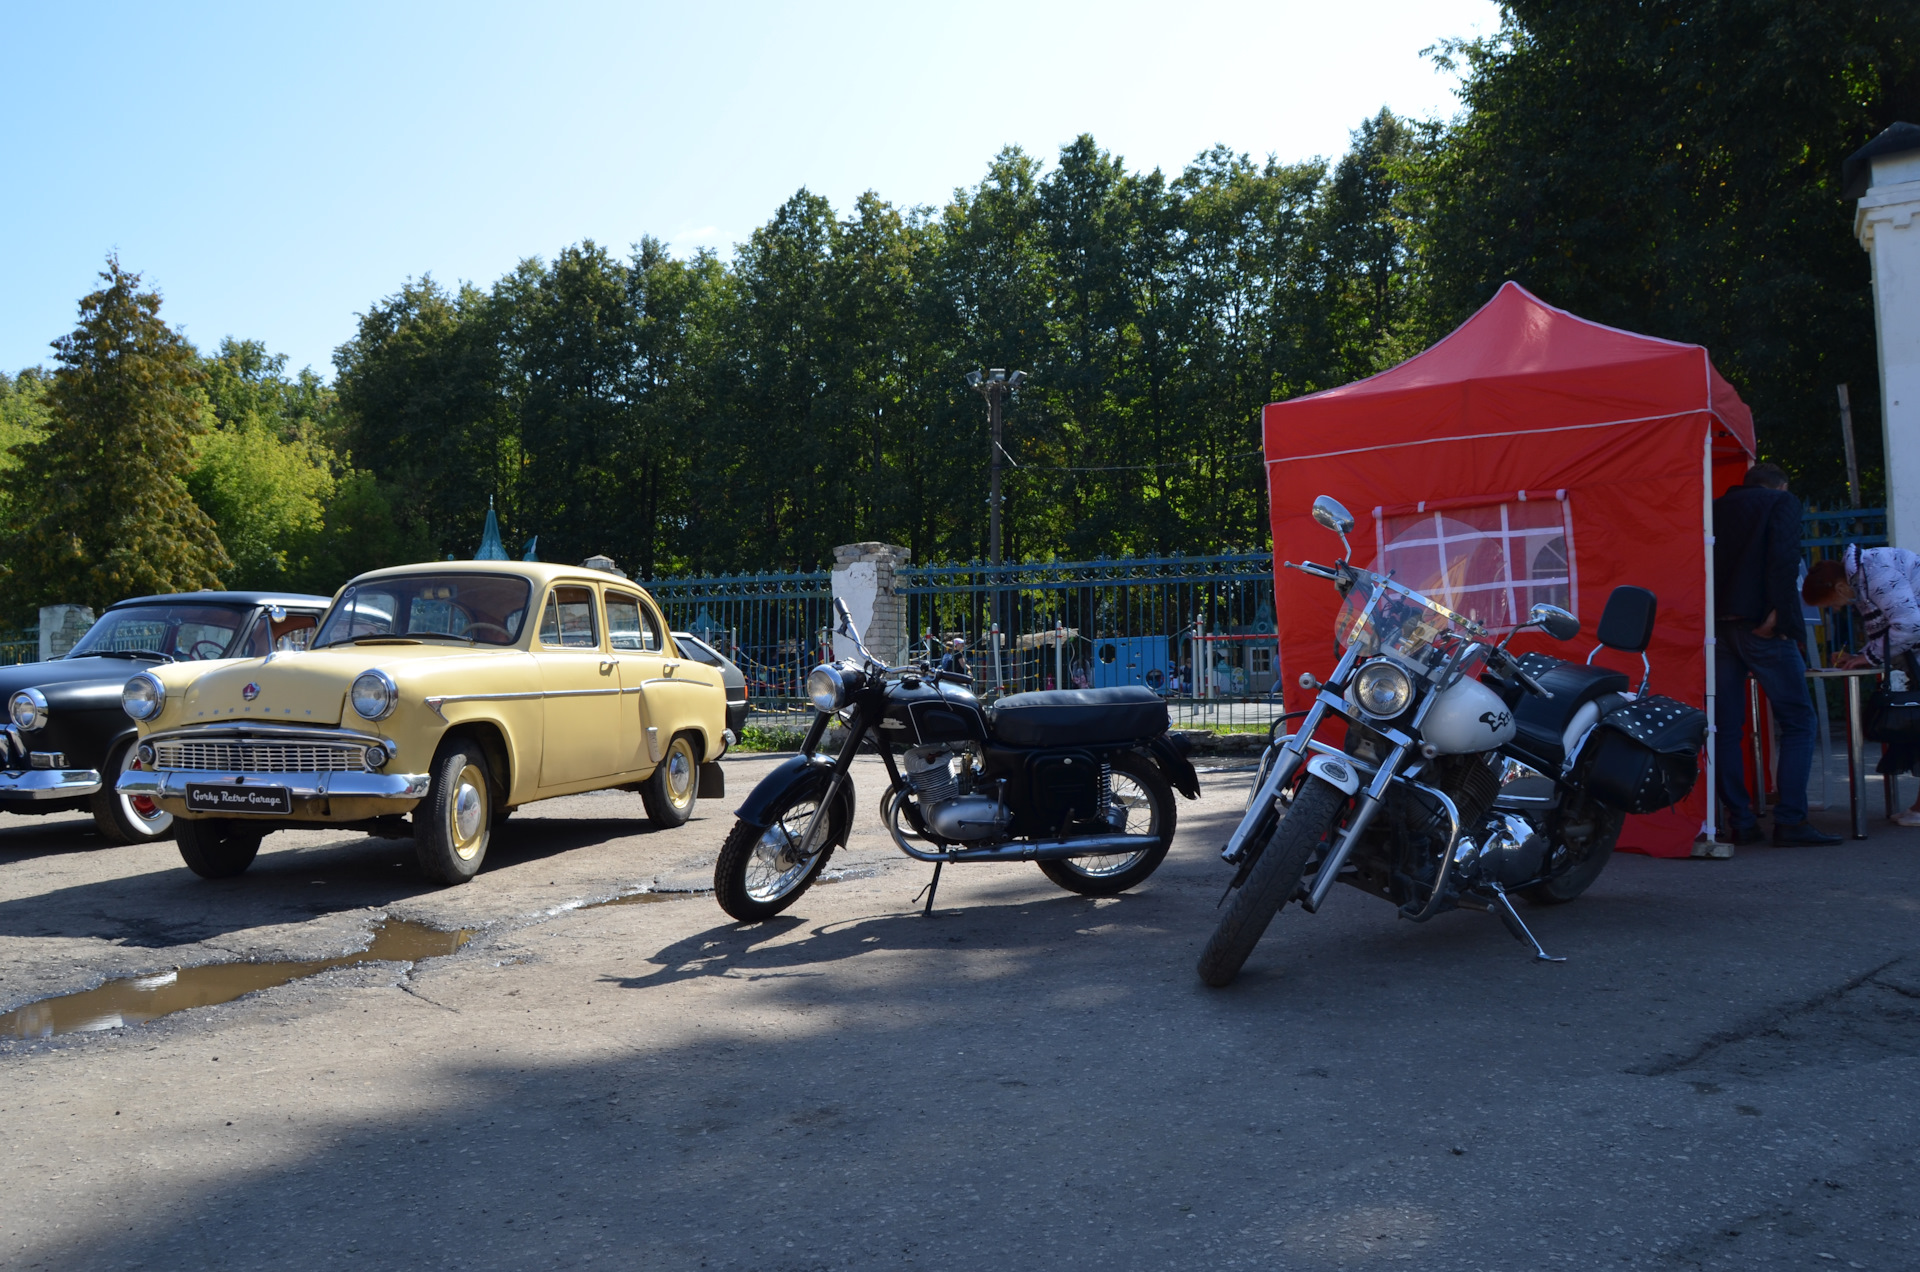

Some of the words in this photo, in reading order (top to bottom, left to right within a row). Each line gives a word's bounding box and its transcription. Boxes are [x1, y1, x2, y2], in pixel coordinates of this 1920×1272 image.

[193, 790, 219, 804] Gorky
[221, 791, 248, 802] Retro
[249, 792, 281, 806] Garage
